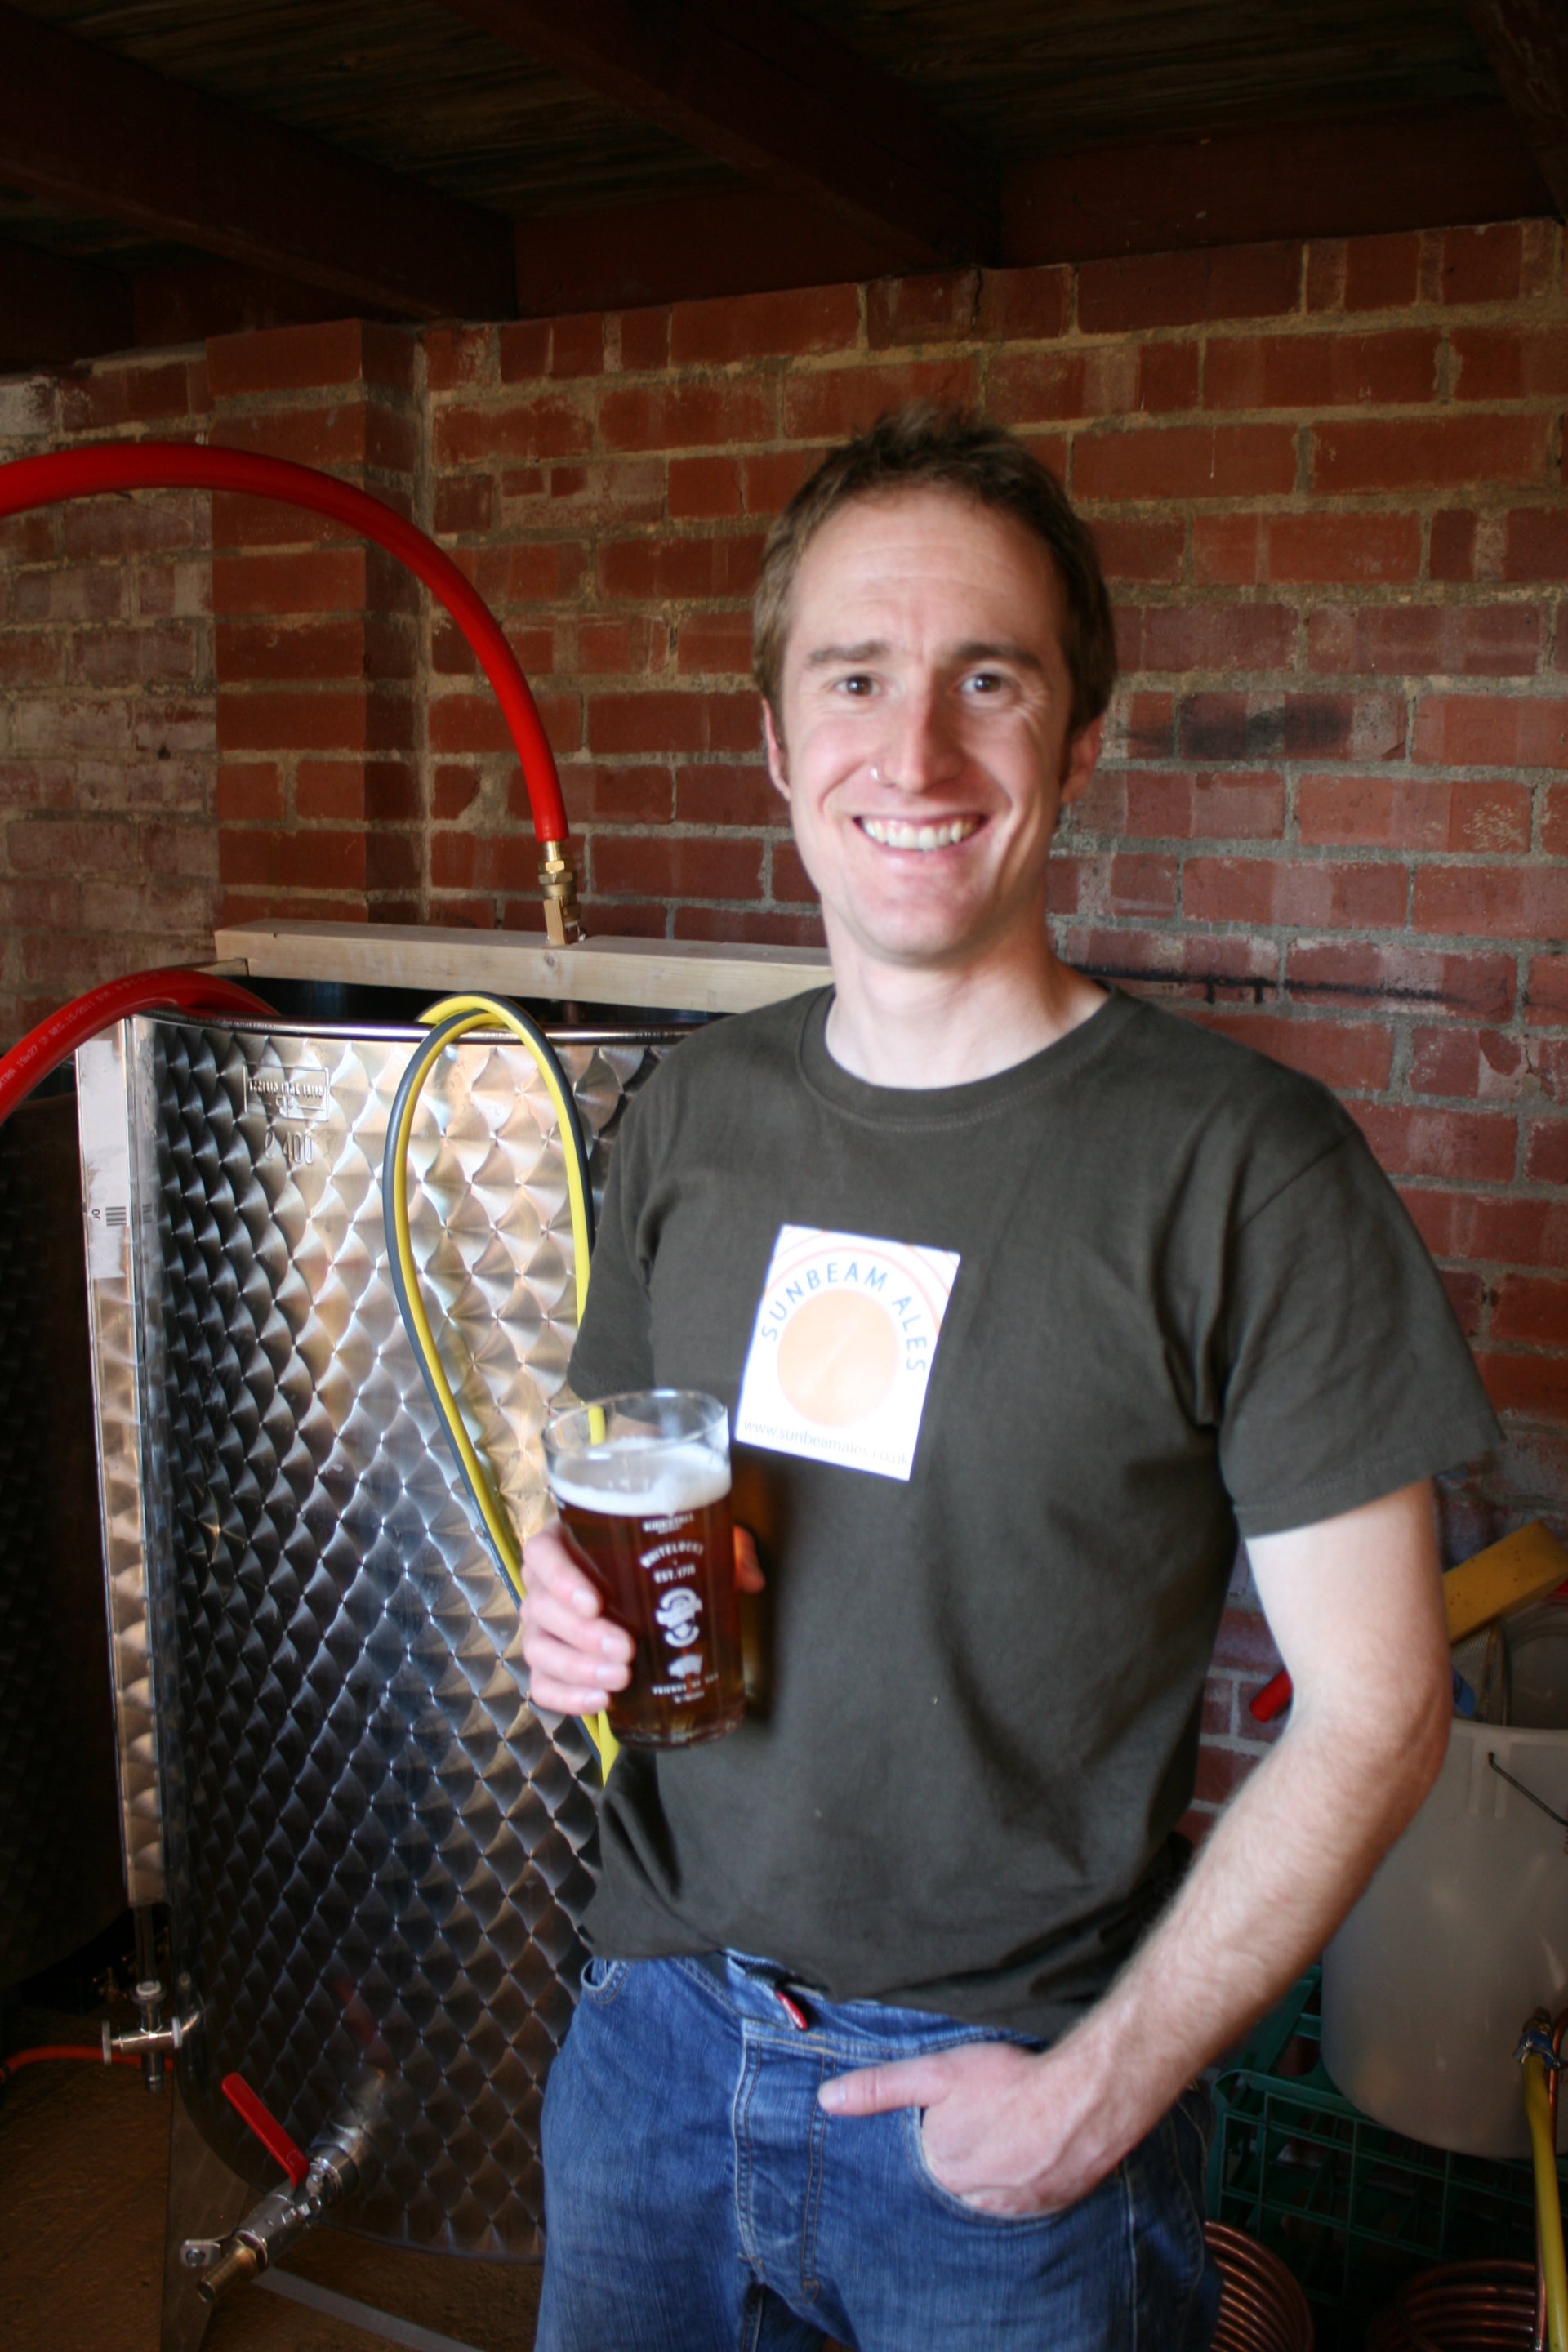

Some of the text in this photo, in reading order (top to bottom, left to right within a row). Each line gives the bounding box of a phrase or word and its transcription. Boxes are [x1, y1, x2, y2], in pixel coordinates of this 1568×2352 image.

[282, 1130, 315, 1166] 400
[761, 1261, 929, 1372] SUNBEAM ALES
[743, 1419, 910, 1468] www.sunbeamales.co.uk
